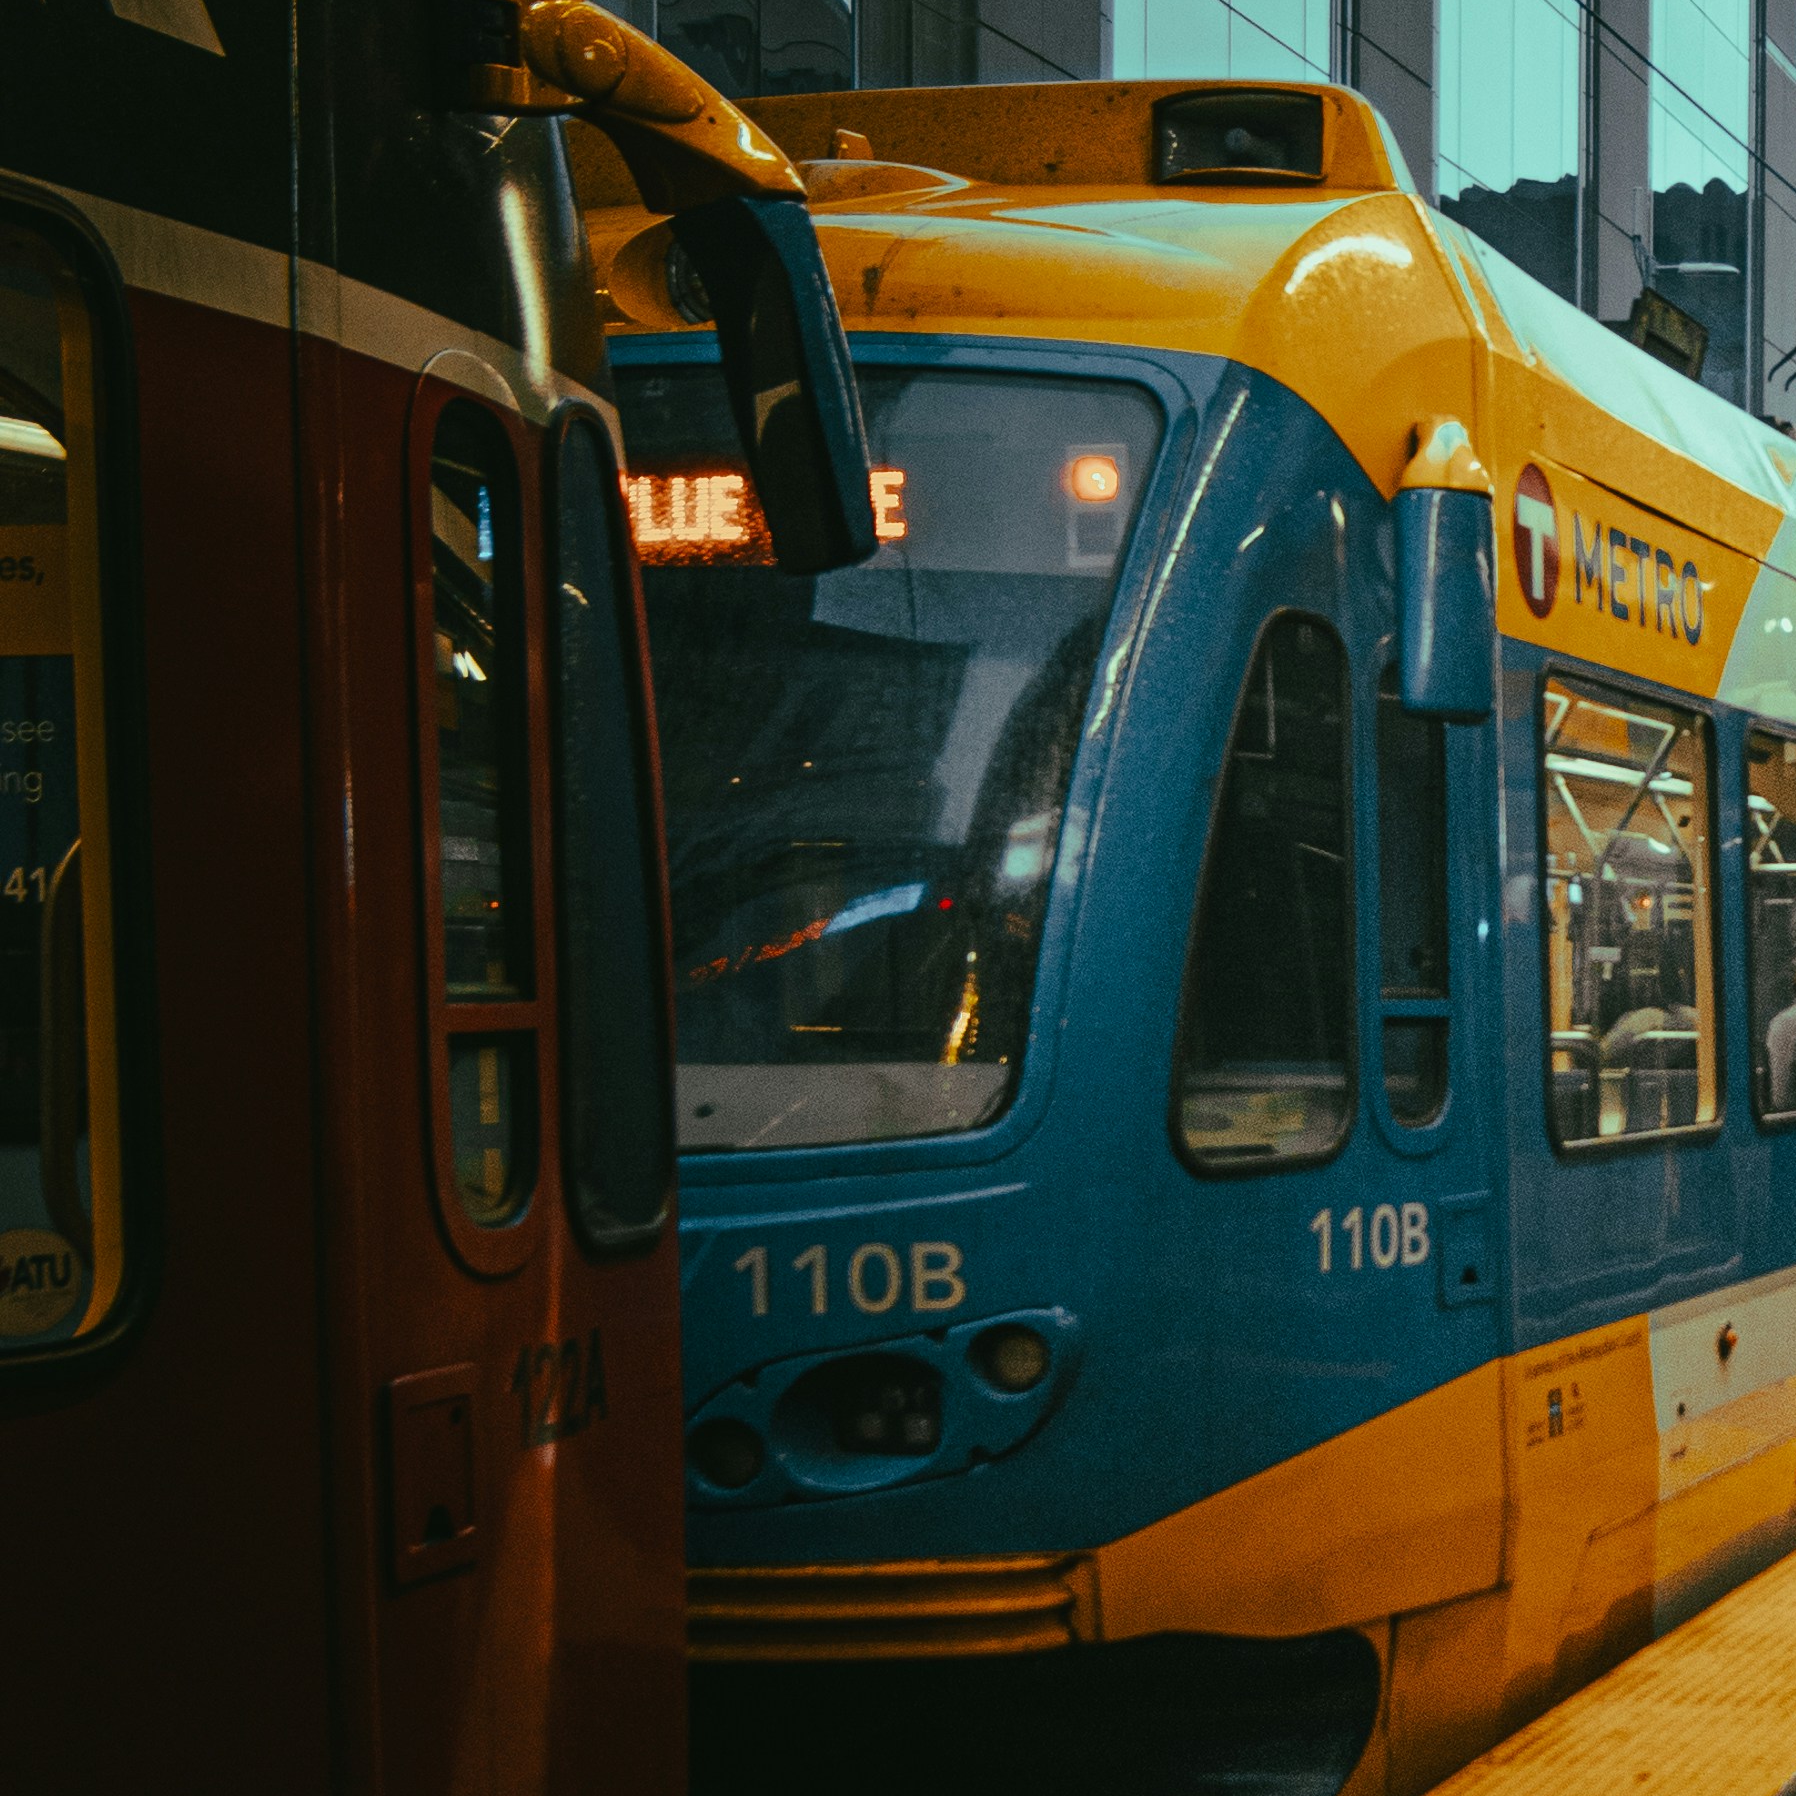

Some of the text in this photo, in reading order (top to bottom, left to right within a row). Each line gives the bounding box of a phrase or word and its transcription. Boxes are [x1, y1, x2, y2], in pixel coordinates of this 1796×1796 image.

[626, 472, 750, 544] LUE
[1572, 509, 1703, 647] METRO
[11, 1252, 72, 1292] ATU
[1308, 1200, 1432, 1273] 110B
[733, 1240, 968, 1317] 110B
